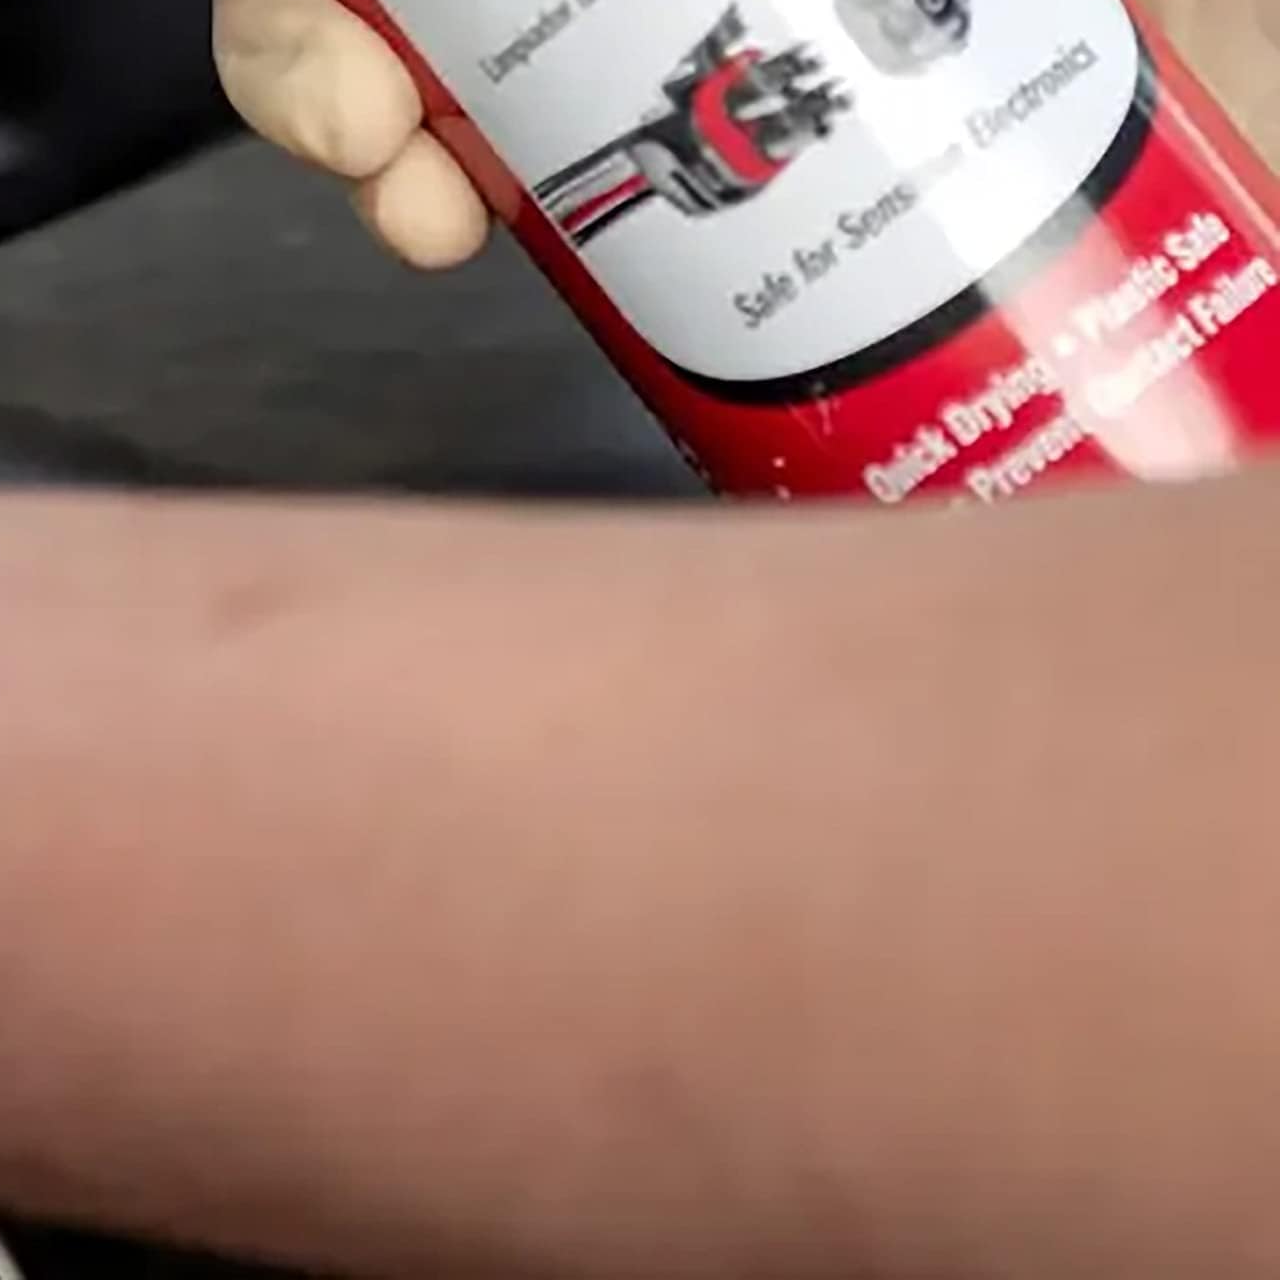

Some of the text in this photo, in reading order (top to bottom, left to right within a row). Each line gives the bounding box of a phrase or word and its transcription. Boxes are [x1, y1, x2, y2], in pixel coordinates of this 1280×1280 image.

[733, 272, 799, 330] Safe
[792, 237, 839, 285] for
[863, 424, 958, 503] Quick
[941, 356, 1051, 448] Drying
[1163, 211, 1231, 271] Safe
